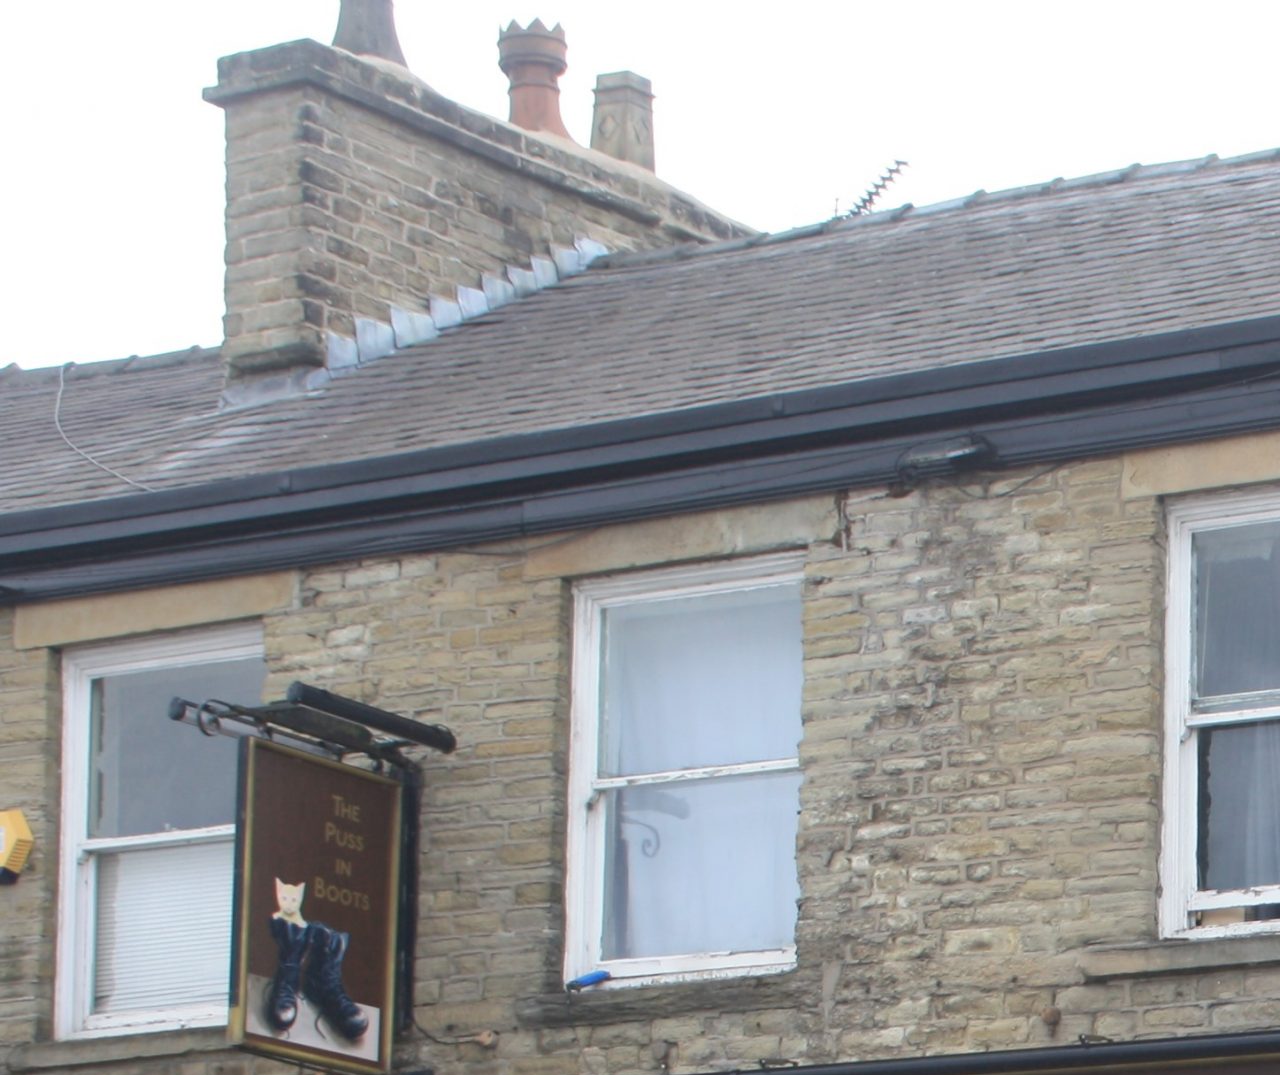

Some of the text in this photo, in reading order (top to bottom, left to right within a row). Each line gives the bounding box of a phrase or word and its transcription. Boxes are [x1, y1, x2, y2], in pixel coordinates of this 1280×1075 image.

[332, 794, 361, 823] THE
[325, 821, 365, 852] PUSS
[336, 858, 352, 877] IN
[315, 876, 370, 911] BOOTS
